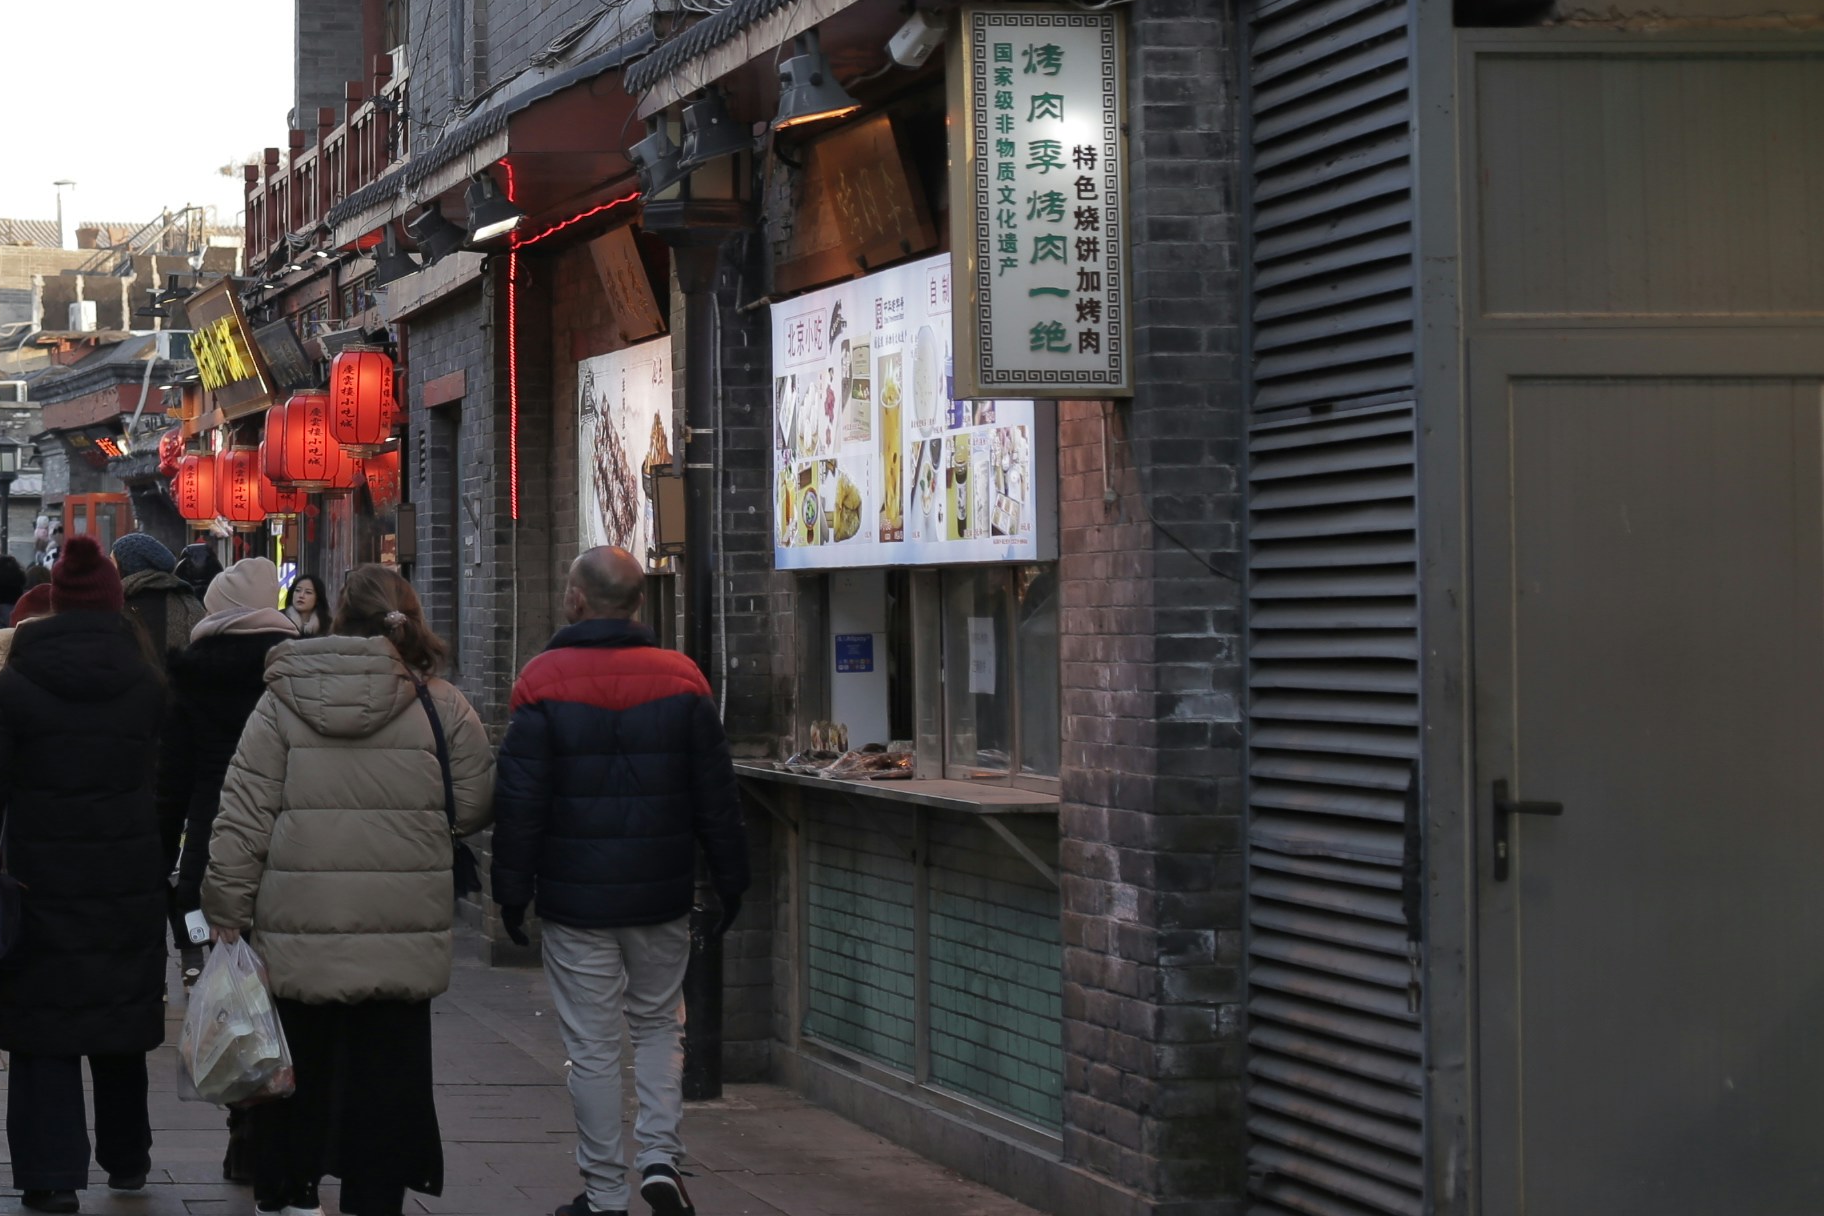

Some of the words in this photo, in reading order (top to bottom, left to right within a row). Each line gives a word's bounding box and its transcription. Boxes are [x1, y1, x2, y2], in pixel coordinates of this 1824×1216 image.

[993, 42, 1018, 277] 国家级非物质文化遗产
[1021, 42, 1072, 354] 烤肉季烤肉一绝
[1072, 144, 1101, 355] 特色烧饼加烤肉
[787, 313, 824, 359] 北京小吃
